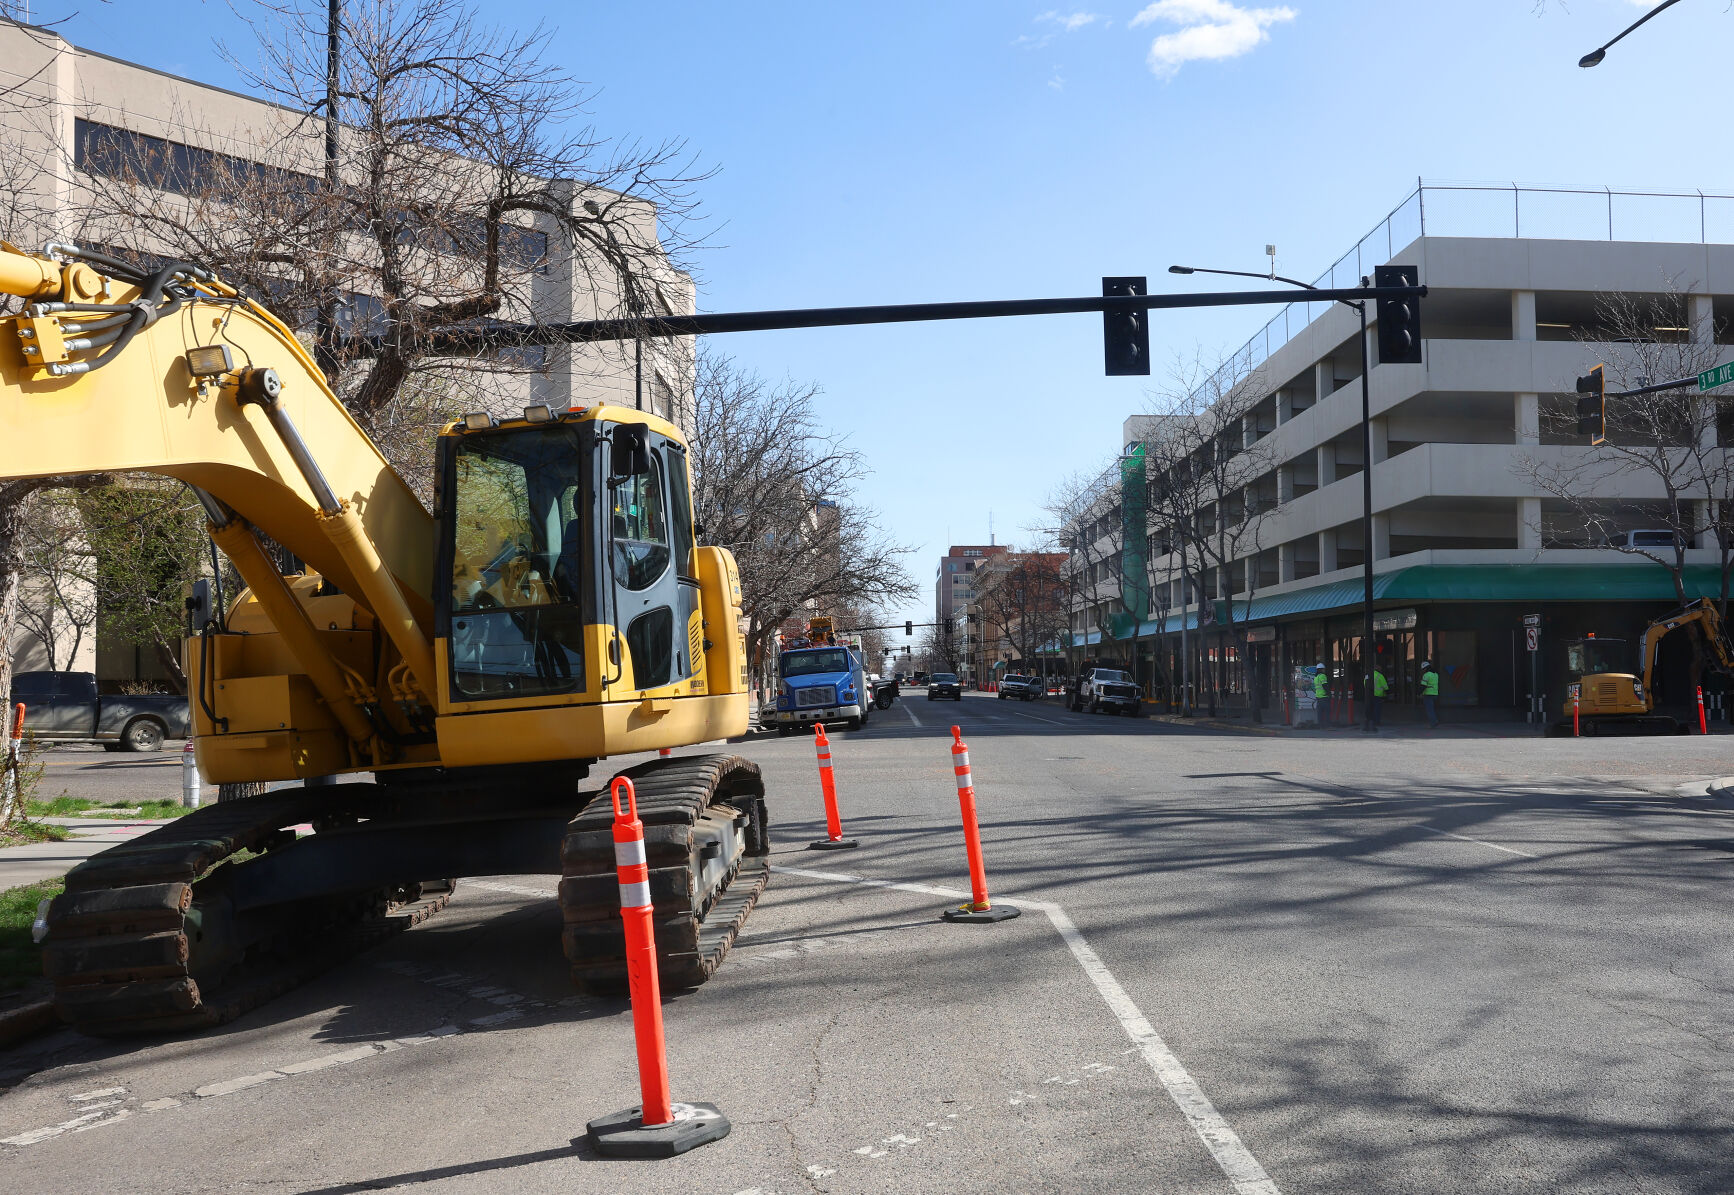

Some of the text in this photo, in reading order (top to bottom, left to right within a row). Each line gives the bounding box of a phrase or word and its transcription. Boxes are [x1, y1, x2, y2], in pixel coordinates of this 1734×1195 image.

[1701, 364, 1732, 389] 3 RD AVE
